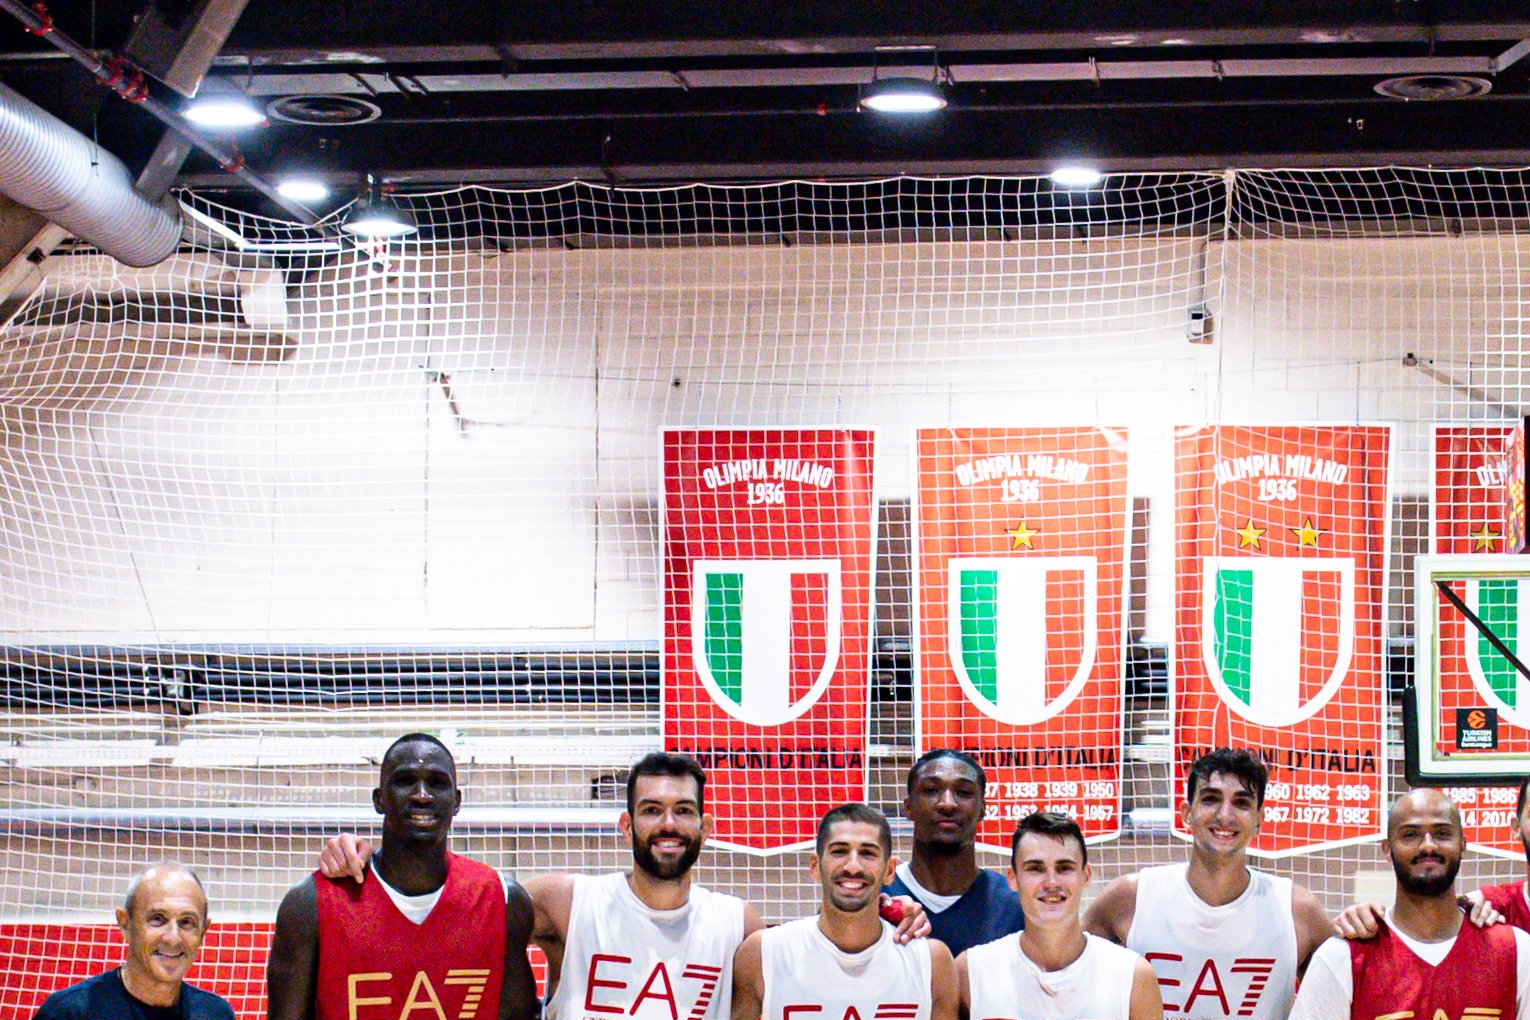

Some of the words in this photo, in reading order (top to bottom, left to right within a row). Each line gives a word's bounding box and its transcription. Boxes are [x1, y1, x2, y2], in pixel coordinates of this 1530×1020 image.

[702, 458, 768, 489] OLIMPIA
[773, 458, 833, 488] MILANO
[956, 454, 1022, 486] OLIMPIA
[1027, 454, 1089, 484] MILANO
[1213, 454, 1280, 485] OLIMPIA
[1285, 454, 1348, 485] MILANO
[747, 482, 785, 504] 1936
[1001, 479, 1040, 502] 1936
[1258, 479, 1297, 501] 1936
[669, 747, 772, 769] MPIONI
[1288, 748, 1376, 772] D'ITALIA
[1005, 782, 1038, 797] 1938
[1044, 782, 1078, 797] 1939
[1084, 782, 1114, 797] 1950
[1264, 784, 1290, 800] 960
[1296, 784, 1330, 800] 1962
[1336, 784, 1370, 801] 1963
[1483, 787, 1517, 804] 1986
[1084, 805, 1114, 820] 1957
[1263, 807, 1289, 822] 967
[1295, 807, 1330, 823] 1972
[1336, 808, 1370, 824] 1982
[1145, 952, 1276, 1016] EA7
